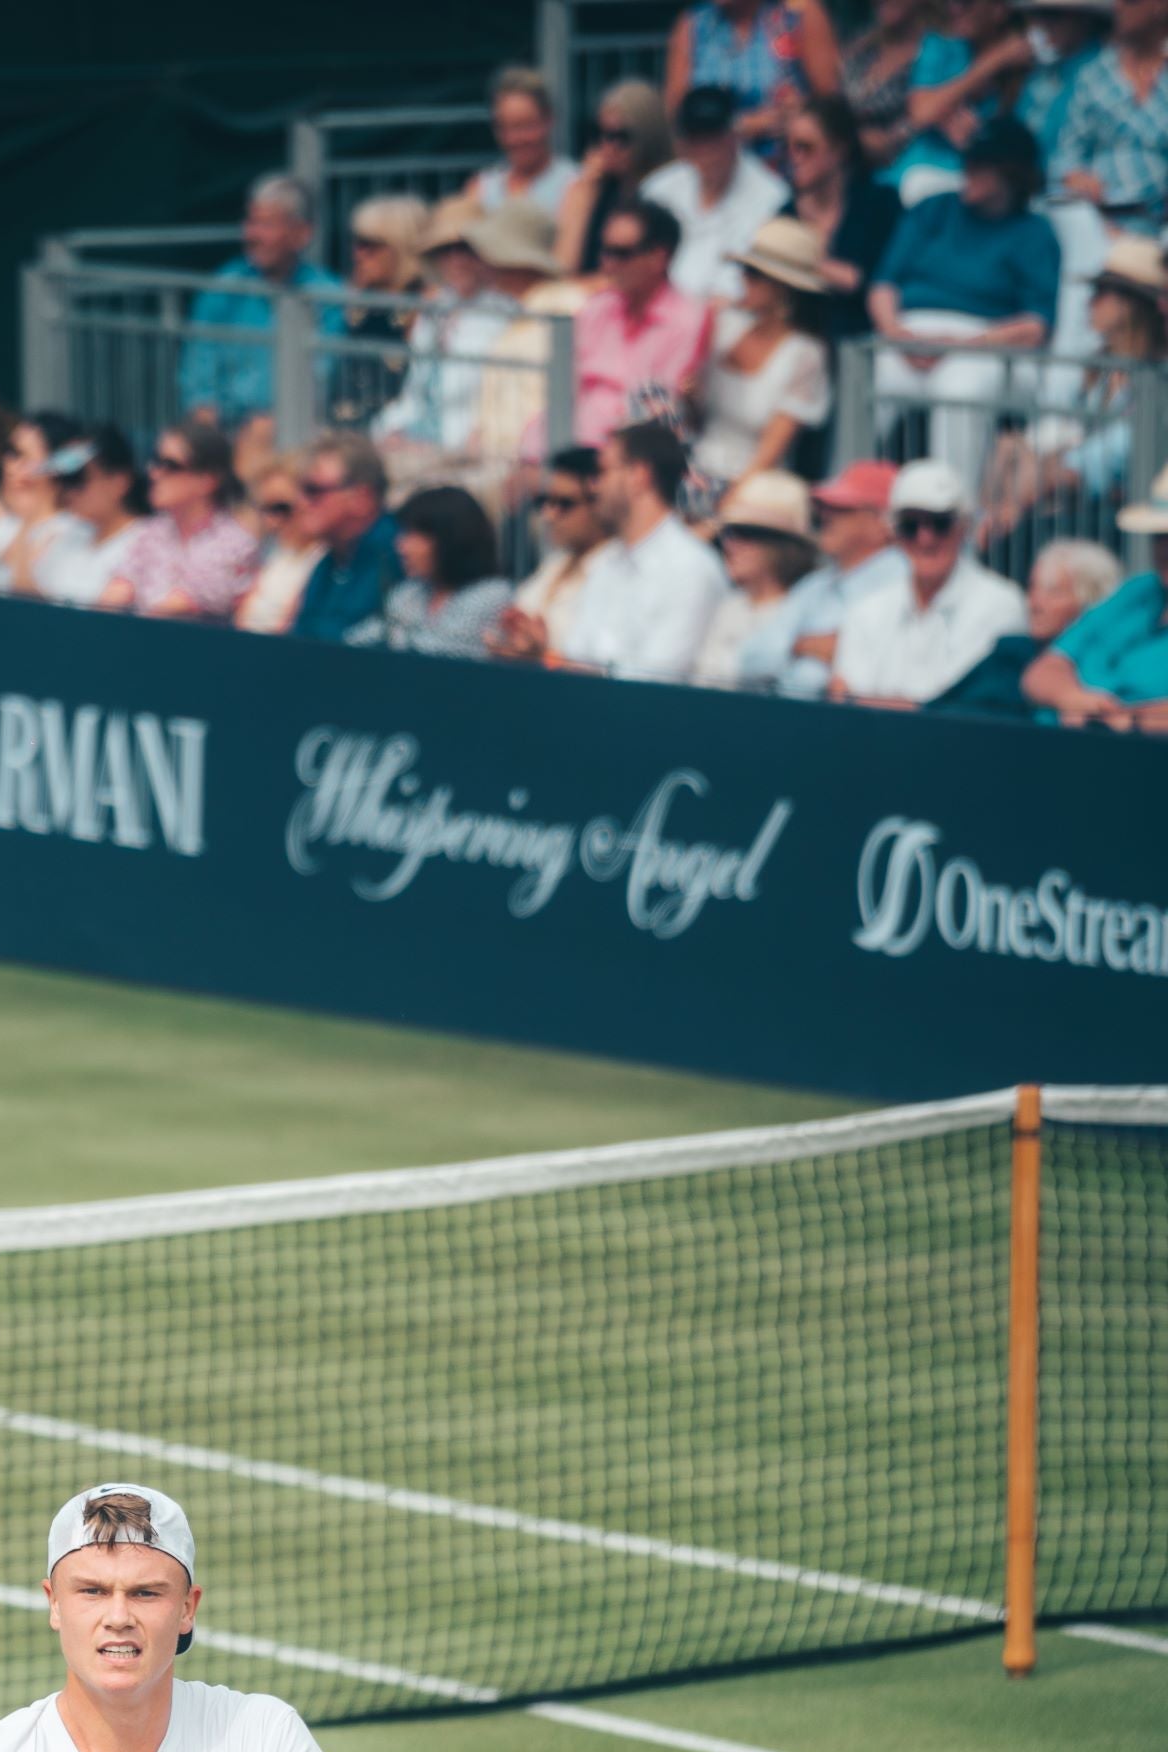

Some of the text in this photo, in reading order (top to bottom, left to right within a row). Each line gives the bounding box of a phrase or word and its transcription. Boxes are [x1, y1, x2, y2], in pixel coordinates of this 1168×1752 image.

[284, 725, 793, 939] Whispering Angel
[934, 855, 1168, 978] OneStrea
